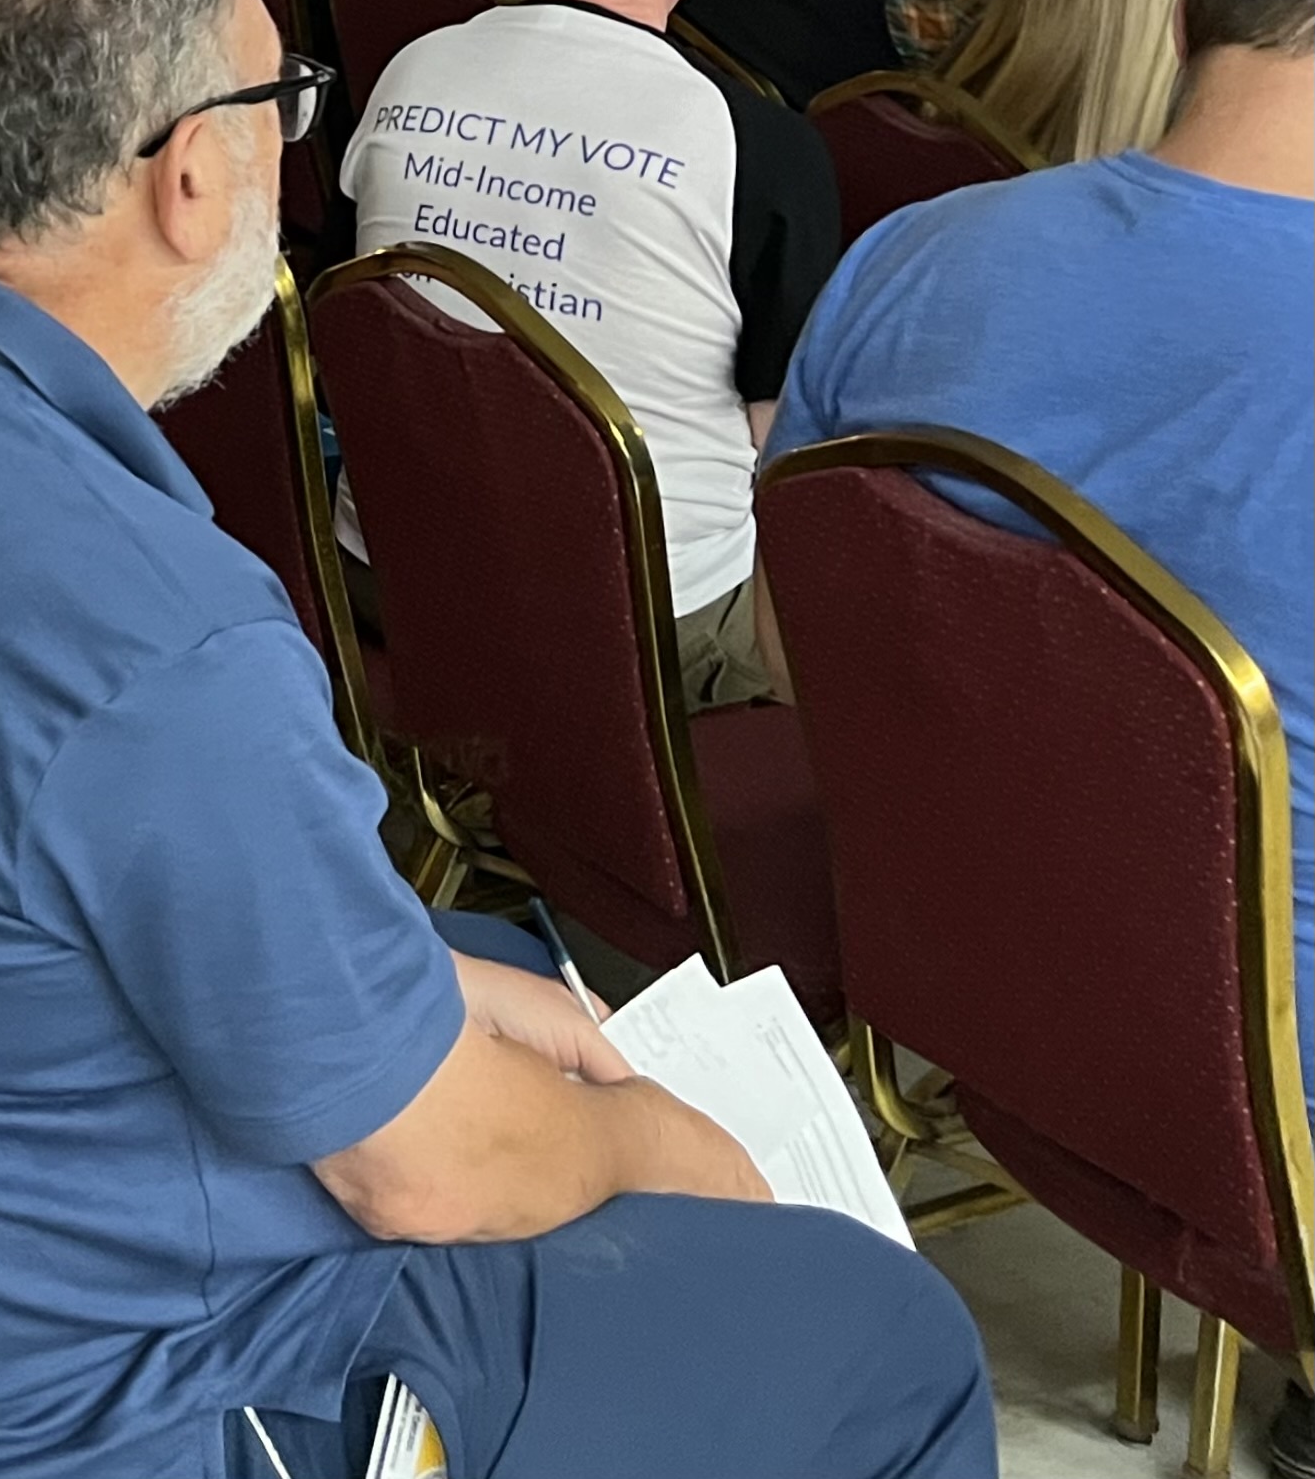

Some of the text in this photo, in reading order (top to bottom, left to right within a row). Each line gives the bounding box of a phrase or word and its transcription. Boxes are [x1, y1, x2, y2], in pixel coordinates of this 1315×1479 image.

[373, 104, 686, 190] PREDICT MY VOTE
[403, 151, 598, 217] Mid-Income
[413, 203, 566, 262] Educated
